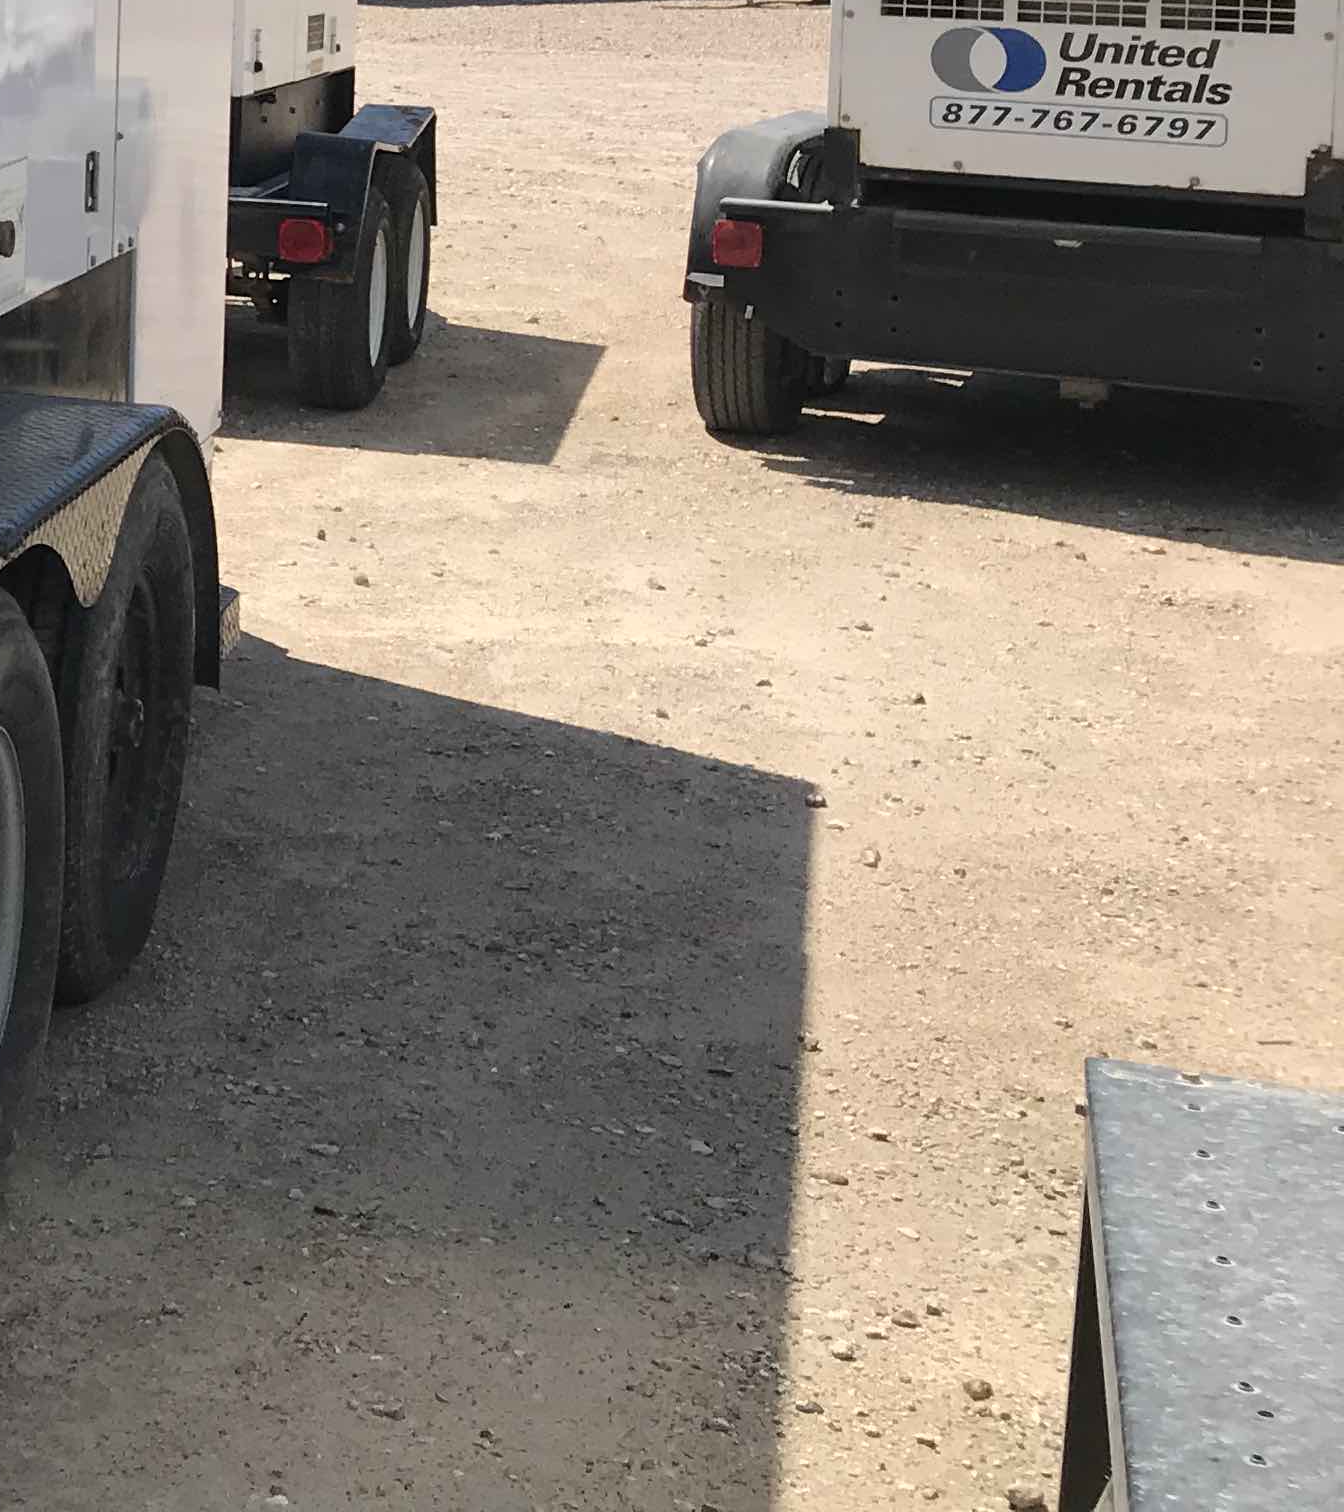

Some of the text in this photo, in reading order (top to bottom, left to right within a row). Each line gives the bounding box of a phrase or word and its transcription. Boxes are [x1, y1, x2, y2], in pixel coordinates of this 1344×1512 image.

[1059, 33, 1221, 69] United
[1056, 67, 1233, 105] Rentals
[942, 103, 1216, 140] 877-767-6797
